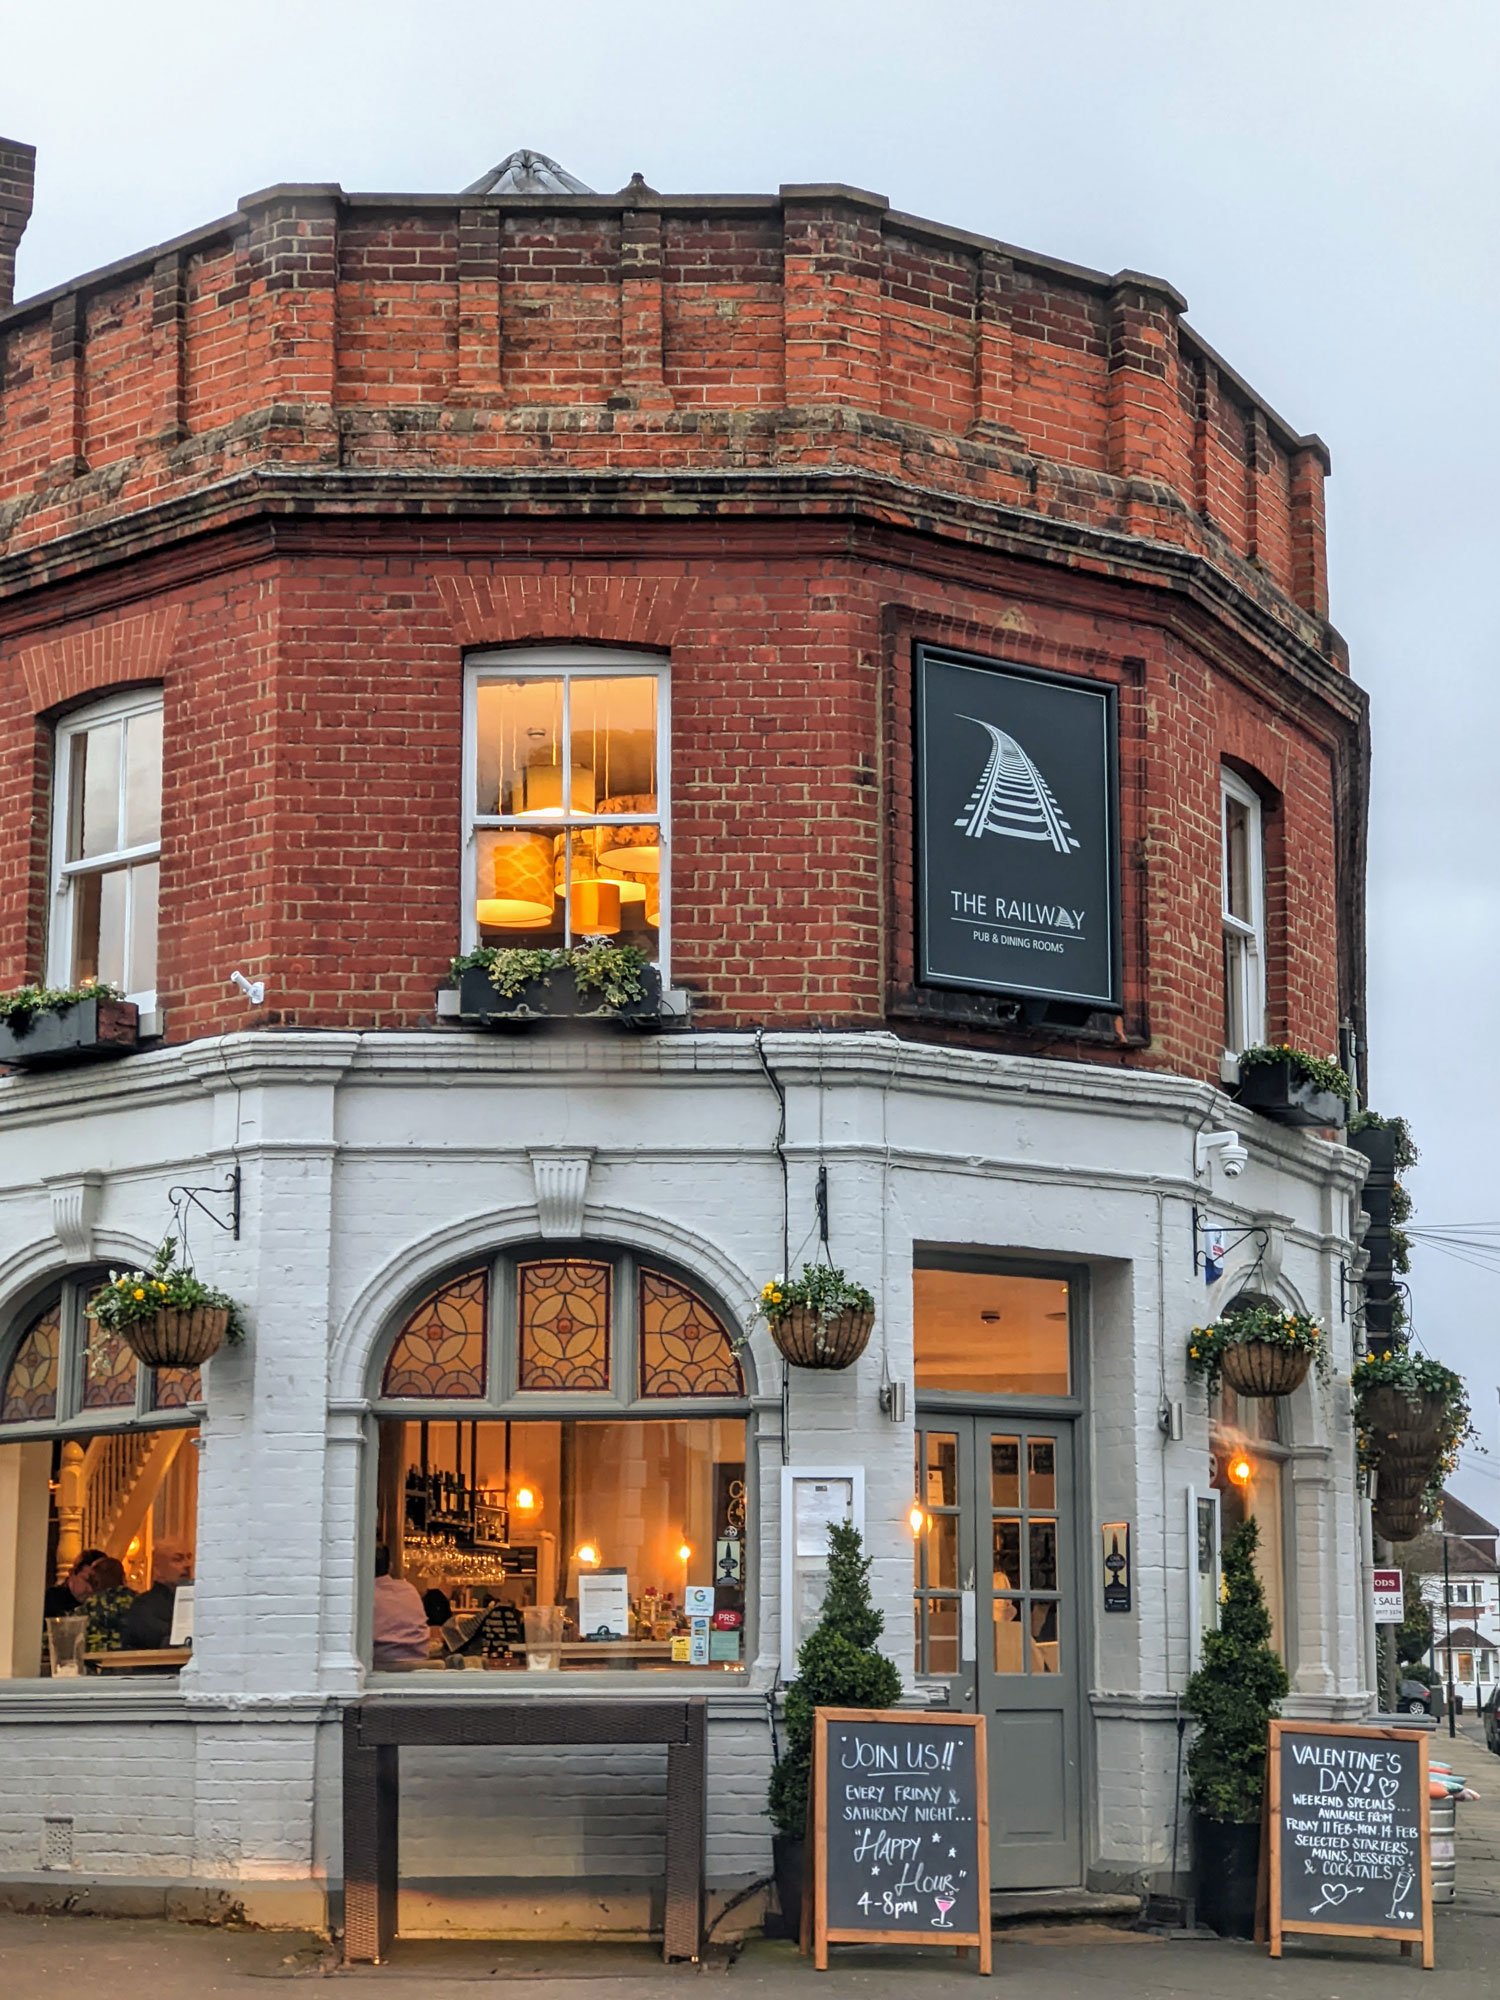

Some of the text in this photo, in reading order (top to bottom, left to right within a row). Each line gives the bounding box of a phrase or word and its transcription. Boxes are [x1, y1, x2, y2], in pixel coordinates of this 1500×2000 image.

[950, 890, 1085, 930] THE RAILWAY
[973, 930, 1064, 953] PUB & DINING ROOMS
[1378, 1596, 1402, 1606] SALE
[718, 1613, 736, 1622] PRS
[1292, 1744, 1402, 1774] VALENTINE'S
[1319, 1767, 1375, 1794] DAY!
[845, 1784, 961, 1805] EVERY FRIDAY &
[1292, 1793, 1344, 1808] WEEKEND
[842, 1805, 909, 1823] SATURDAY
[1318, 1808, 1393, 1824] AVAILABLE FROM
[1286, 1817, 1319, 1833] FRIDAY
[1322, 1821, 1331, 1833] 11
[1395, 1825, 1418, 1839] FEB
[1294, 1834, 1414, 1857] SELECTED STARTERS,
[1312, 1848, 1406, 1867] MAINS, DESSERTS
[1304, 1859, 1393, 1880] & COCKTAILS
[857, 1891, 918, 1919] 4-8pm
